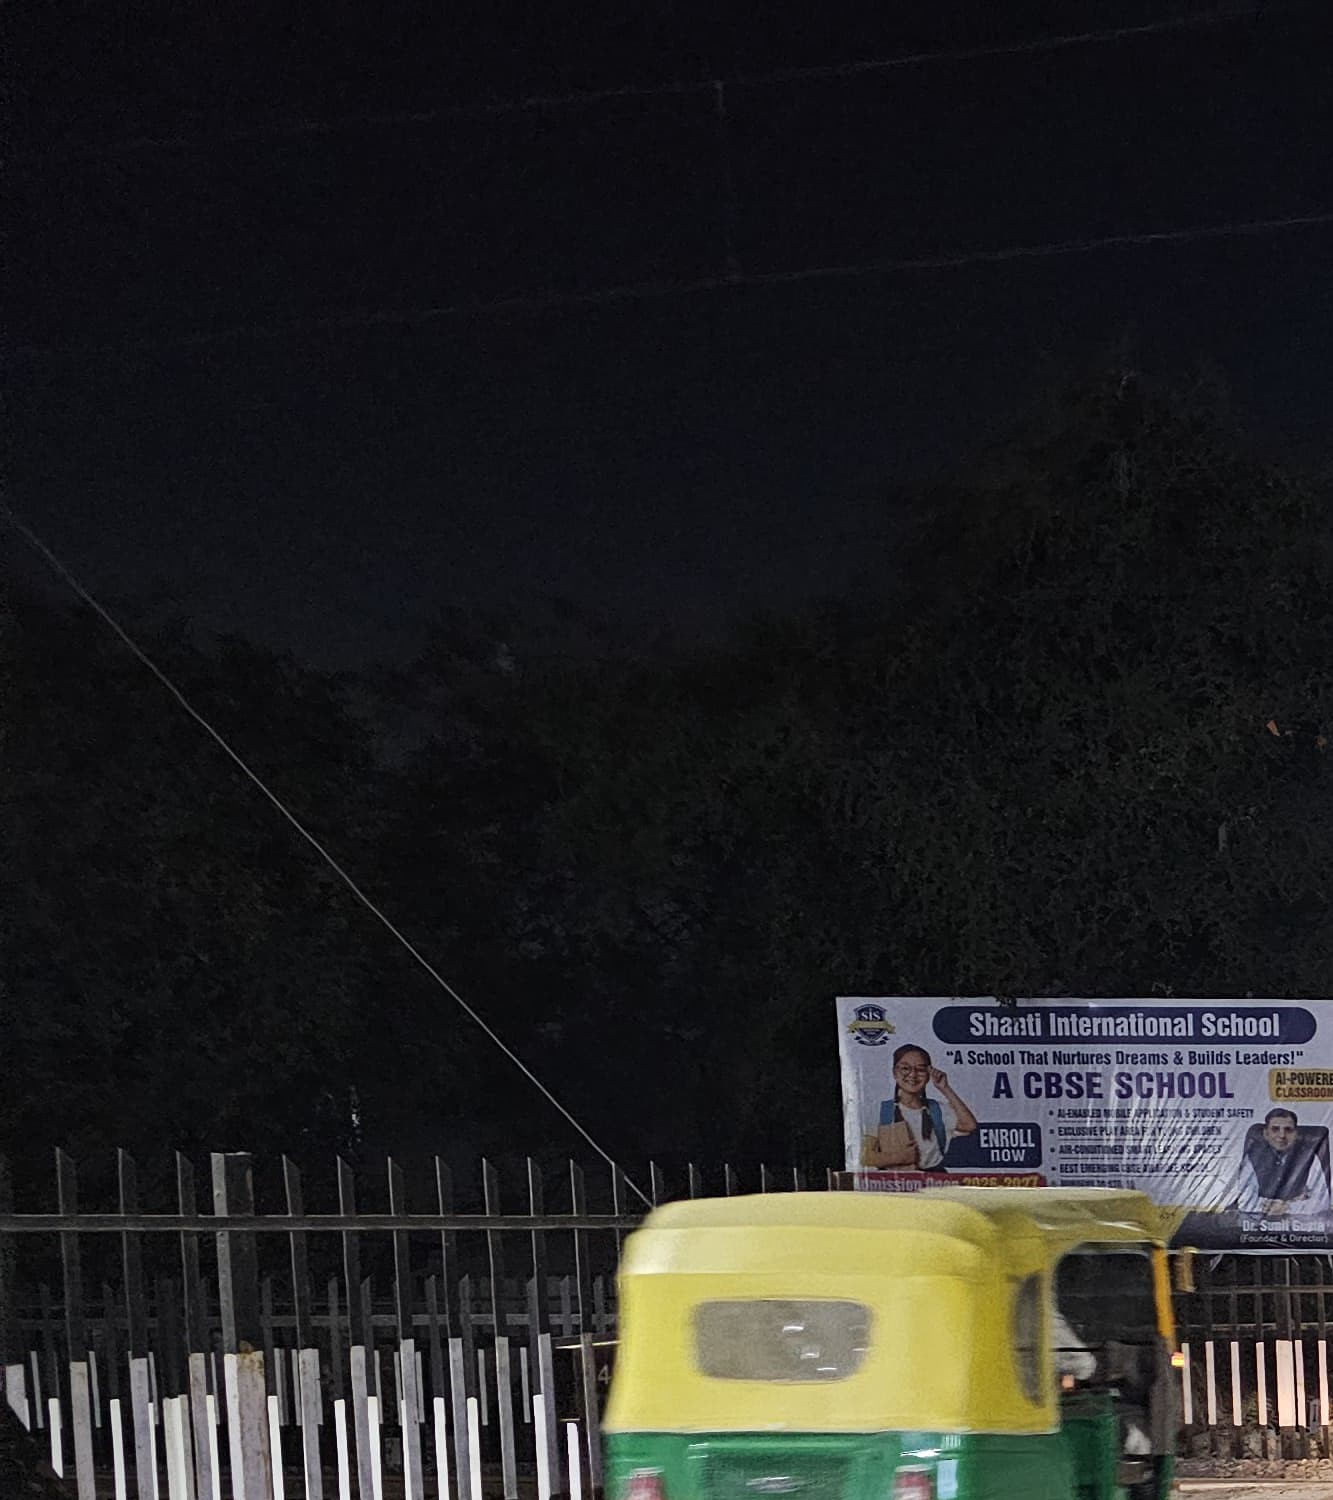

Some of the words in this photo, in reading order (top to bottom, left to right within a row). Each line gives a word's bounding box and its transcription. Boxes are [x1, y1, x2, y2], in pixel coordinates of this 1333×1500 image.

[970, 1012, 1041, 1037] Shanti
[1050, 1012, 1194, 1037] International
[1201, 1012, 1280, 1037] School
[968, 1050, 1015, 1065] School
[1019, 1050, 1048, 1065] That
[1053, 1050, 1112, 1066] Nurtures
[1116, 1050, 1169, 1066] Dreams
[1173, 1051, 1184, 1066] &
[1189, 1050, 1231, 1065] Builds
[992, 1072, 1014, 1099] A
[1023, 1071, 1104, 1100] CBSE
[1115, 1071, 1235, 1100] SCHOOL
[1227, 1108, 1254, 1118] SAFETY
[979, 1128, 1036, 1149] ENROLL
[859, 1175, 923, 1191] Admission
[1242, 1220, 1258, 1232] Dr.
[1289, 1234, 1329, 1243] Director)
